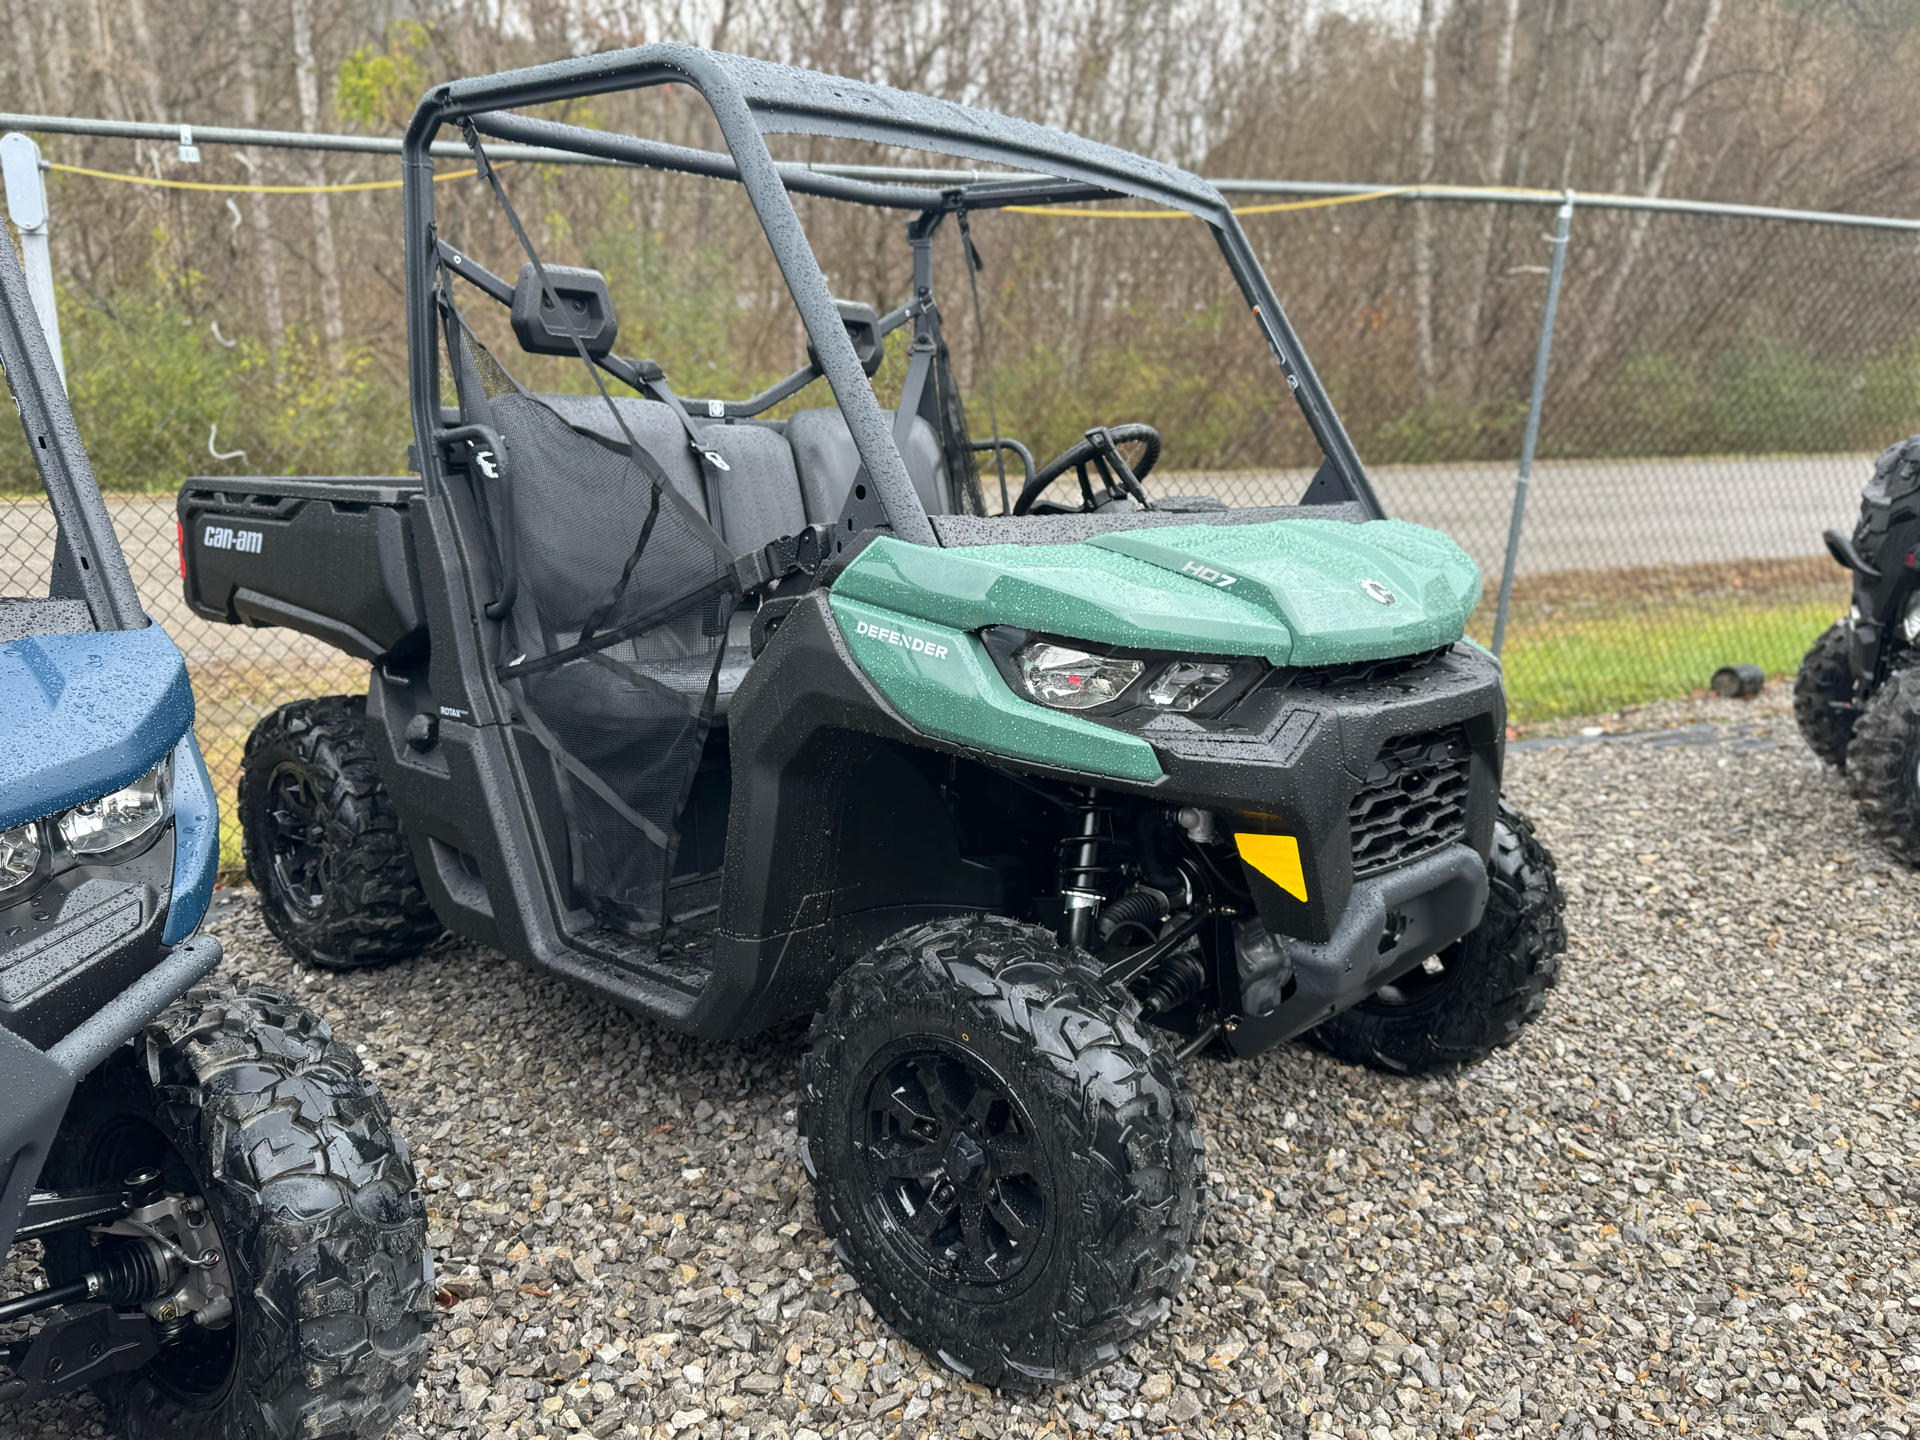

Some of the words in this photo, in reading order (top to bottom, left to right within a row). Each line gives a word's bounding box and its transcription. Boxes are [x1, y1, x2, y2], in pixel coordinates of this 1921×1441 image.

[204, 526, 263, 553] can-am
[1181, 560, 1237, 587] HD7
[856, 620, 949, 660] DEFENDER
[440, 705, 461, 718] ROTAX
